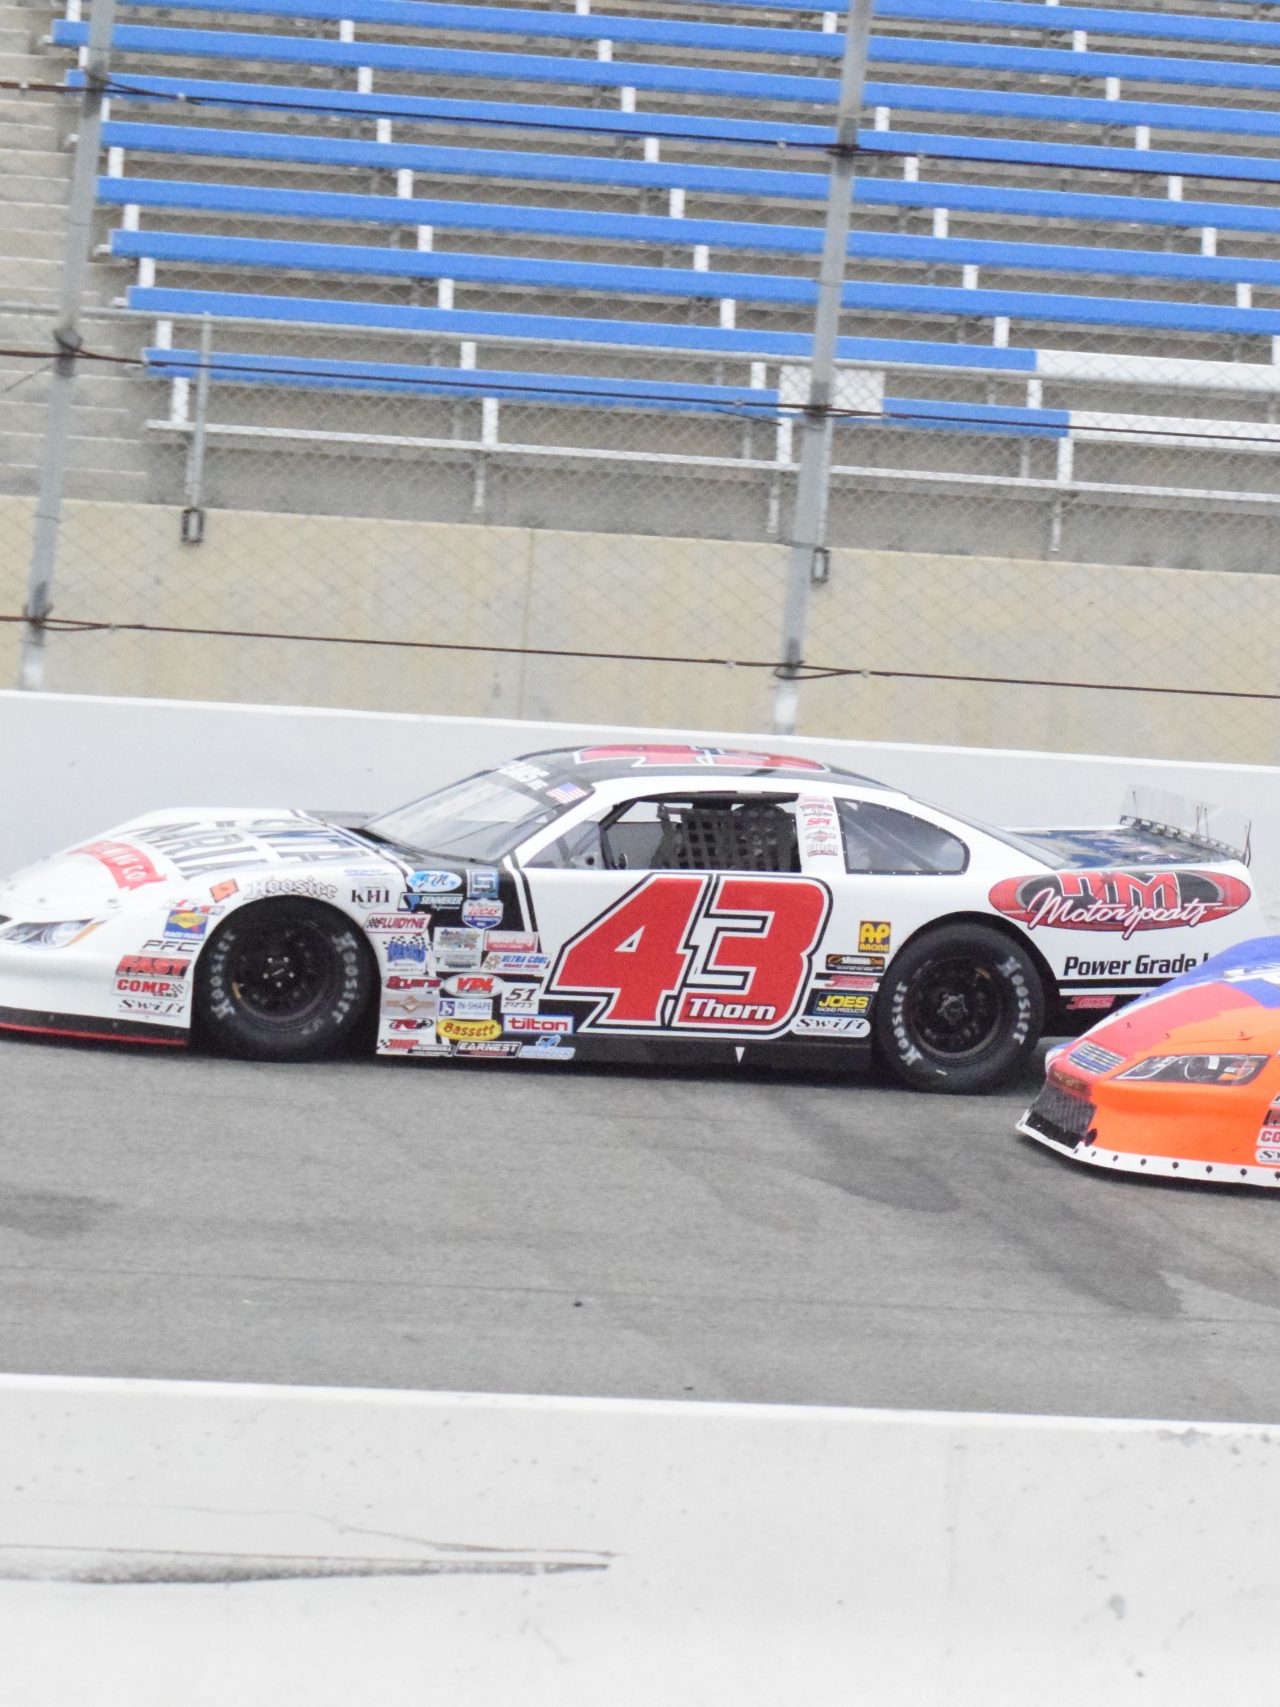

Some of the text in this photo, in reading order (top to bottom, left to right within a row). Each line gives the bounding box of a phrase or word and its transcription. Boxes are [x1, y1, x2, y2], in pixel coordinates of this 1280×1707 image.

[244, 876, 338, 900] Hoosier
[351, 889, 389, 903] KHI
[1026, 887, 1223, 940] Motorsports
[378, 917, 426, 929] FLUIDYNE
[142, 939, 199, 952] PFC
[545, 875, 828, 1033] 43
[118, 955, 191, 976] FAST
[1063, 956, 1132, 976] Power
[1135, 953, 1197, 974] Grade
[117, 978, 170, 994] COMP
[506, 988, 537, 1000] 51
[119, 999, 185, 1013] Swift
[818, 995, 869, 1008] JOES
[686, 997, 777, 1021] Thorn
[443, 1022, 495, 1037] Bassett
[508, 1017, 569, 1031] tilton
[796, 1018, 865, 1030] Swift
[459, 1042, 518, 1052] EARNEST
